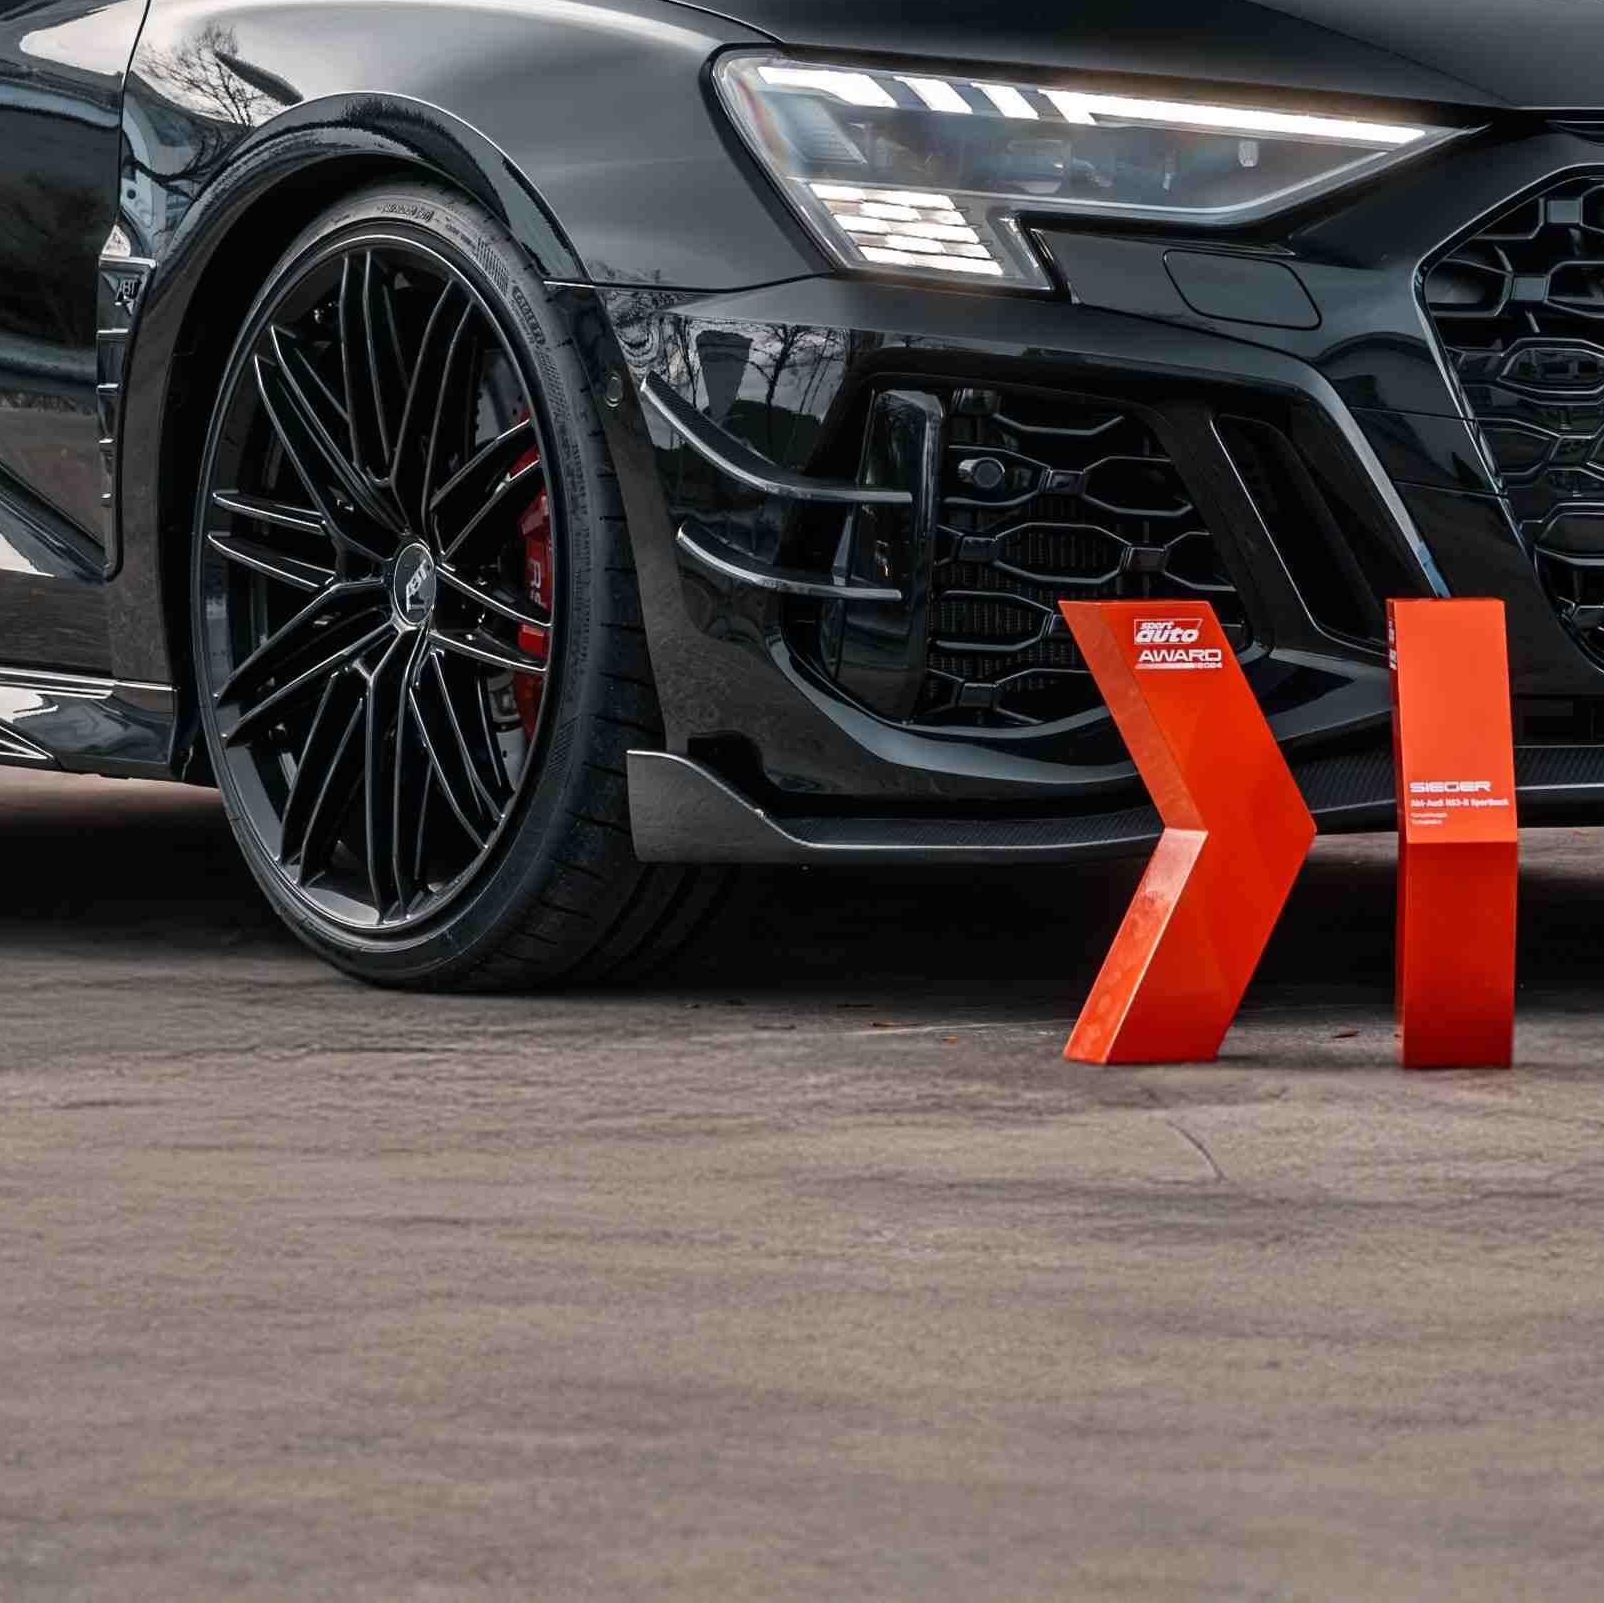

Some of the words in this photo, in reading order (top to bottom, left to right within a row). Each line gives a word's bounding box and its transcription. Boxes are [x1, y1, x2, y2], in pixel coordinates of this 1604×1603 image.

[1140, 621, 1174, 630] sport
[1136, 627, 1199, 643] auto
[1138, 649, 1222, 662] AWARD
